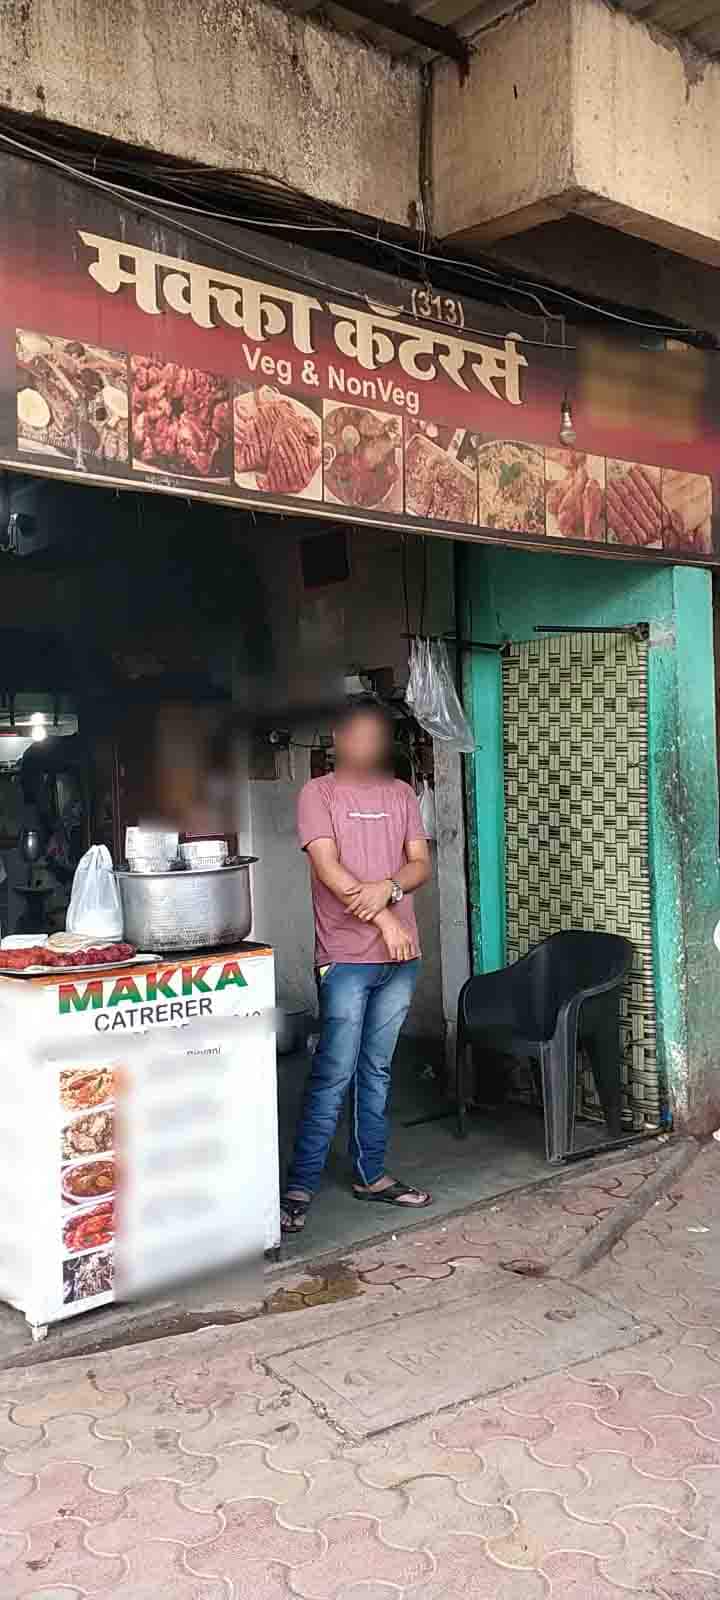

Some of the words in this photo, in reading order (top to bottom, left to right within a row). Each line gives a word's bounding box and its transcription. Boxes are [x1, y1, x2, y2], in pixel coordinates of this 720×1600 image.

[77, 230, 323, 355] मक्का
[411, 288, 465, 332] (313)
[242, 343, 293, 385] Veg
[301, 359, 320, 387] &
[327, 365, 420, 415] NonVeg
[58, 961, 248, 1015] MAKKA
[94, 997, 213, 1033] CATRERER
